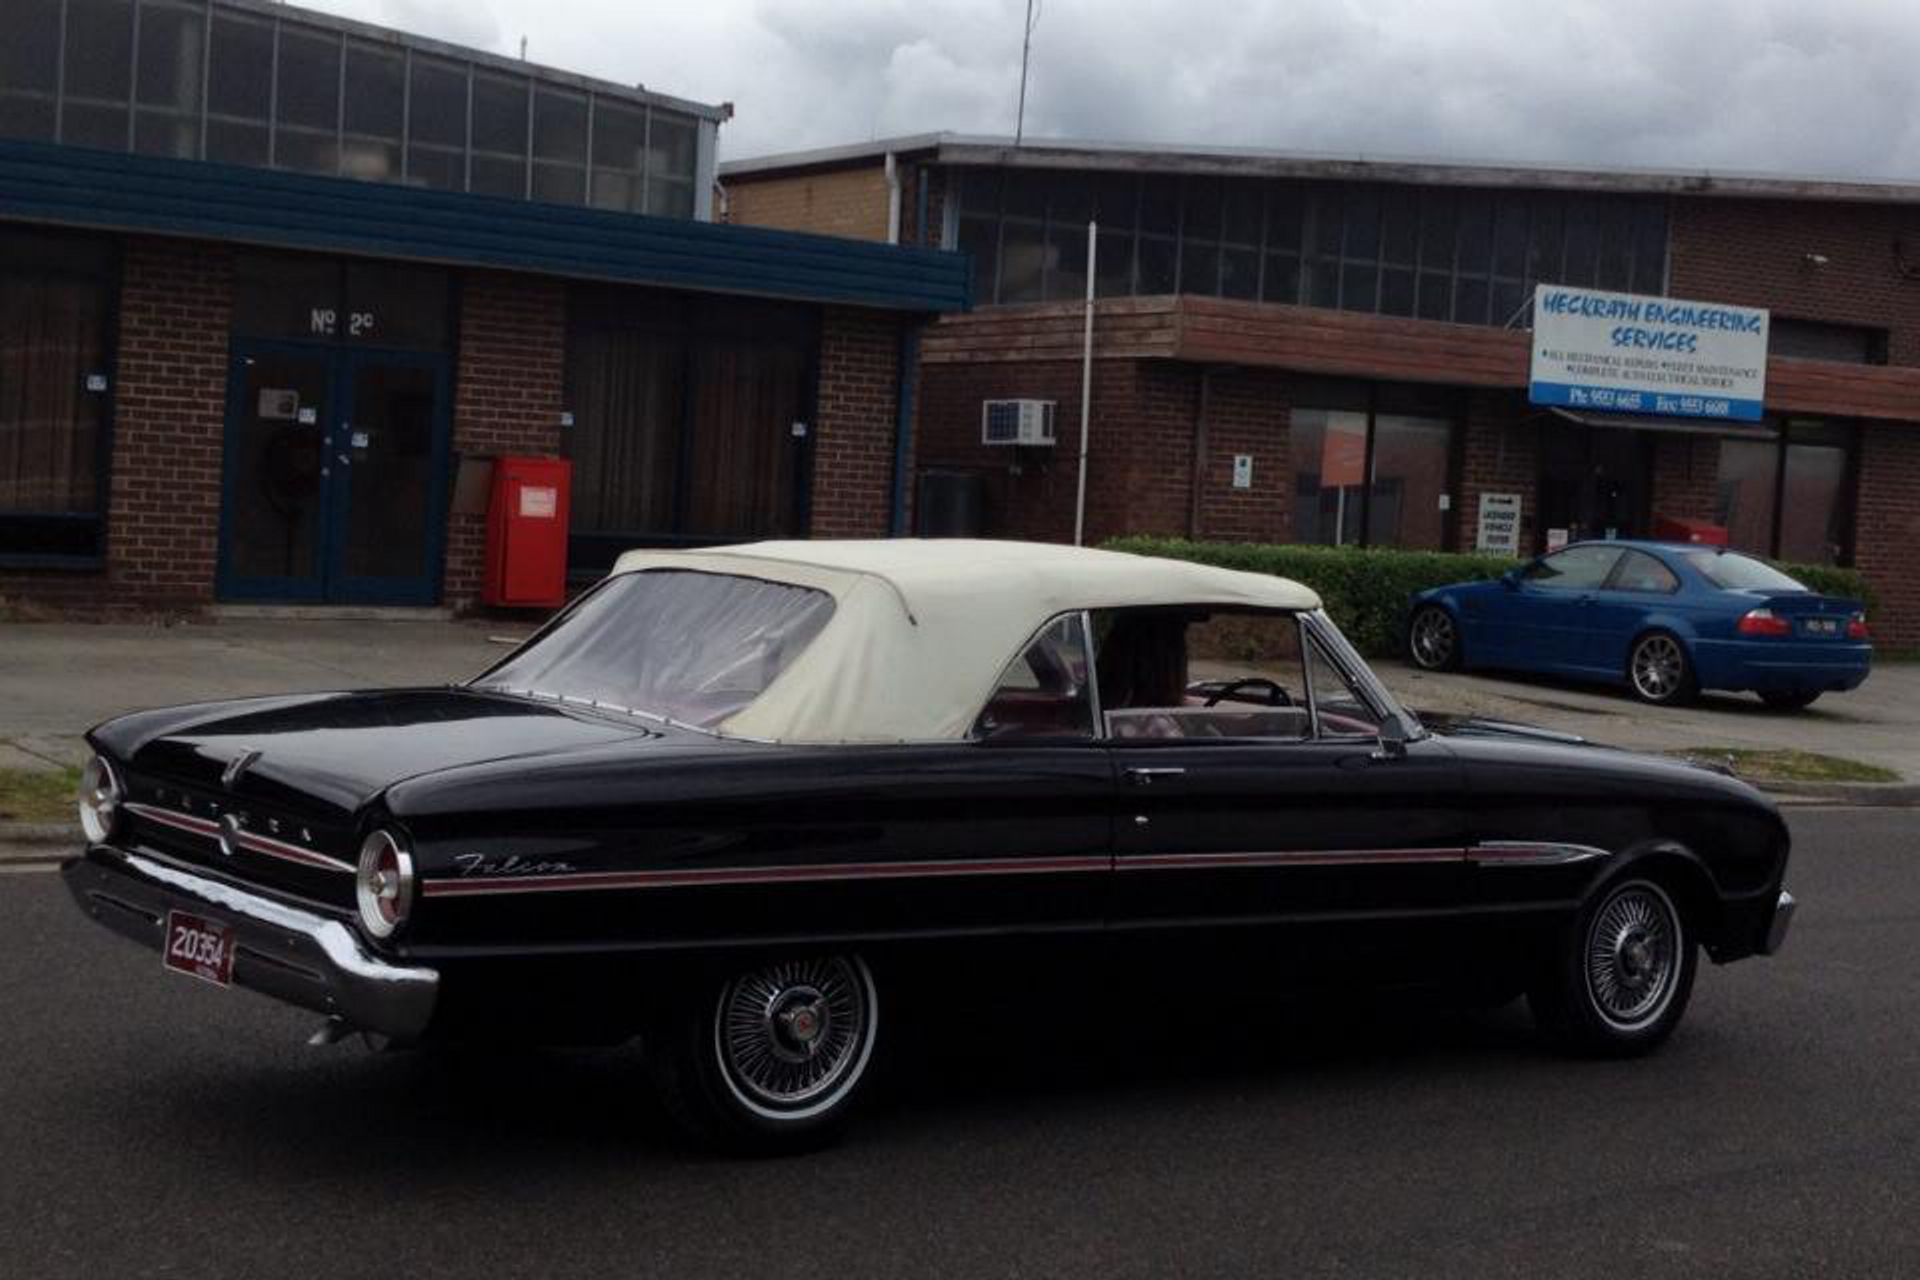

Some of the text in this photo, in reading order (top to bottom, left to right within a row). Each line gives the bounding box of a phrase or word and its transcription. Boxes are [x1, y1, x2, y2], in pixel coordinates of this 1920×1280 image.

[1645, 303, 1761, 335] ENGINEERING
[1611, 325, 1697, 353] SERVICES
[171, 926, 224, 967] 20354
